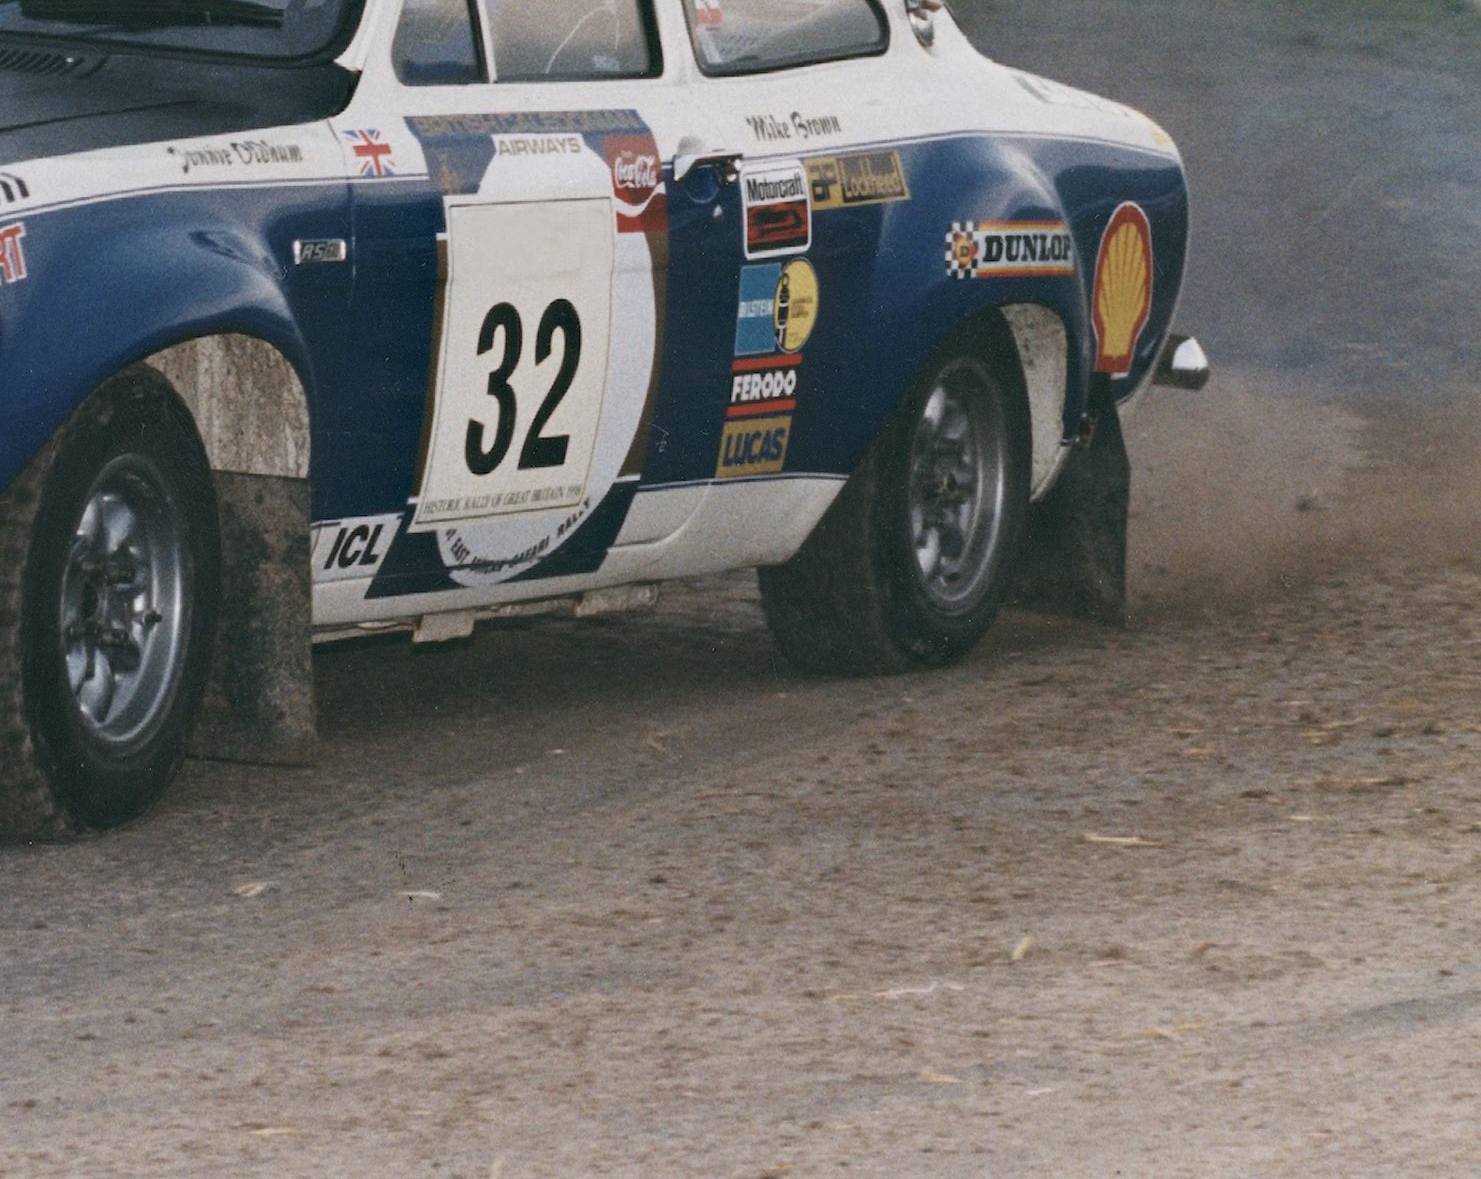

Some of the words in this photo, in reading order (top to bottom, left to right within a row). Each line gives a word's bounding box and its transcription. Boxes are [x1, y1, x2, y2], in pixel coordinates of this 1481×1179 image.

[746, 114, 789, 141] Mike
[790, 111, 841, 139] Brown
[498, 136, 581, 157] AIRWAYS
[747, 172, 805, 202] Motorcraft
[982, 231, 1071, 263] DUNLOP
[465, 297, 582, 476] 32
[730, 369, 798, 403] FERODO
[722, 427, 786, 467] LUCAS
[323, 524, 385, 570] ICL
